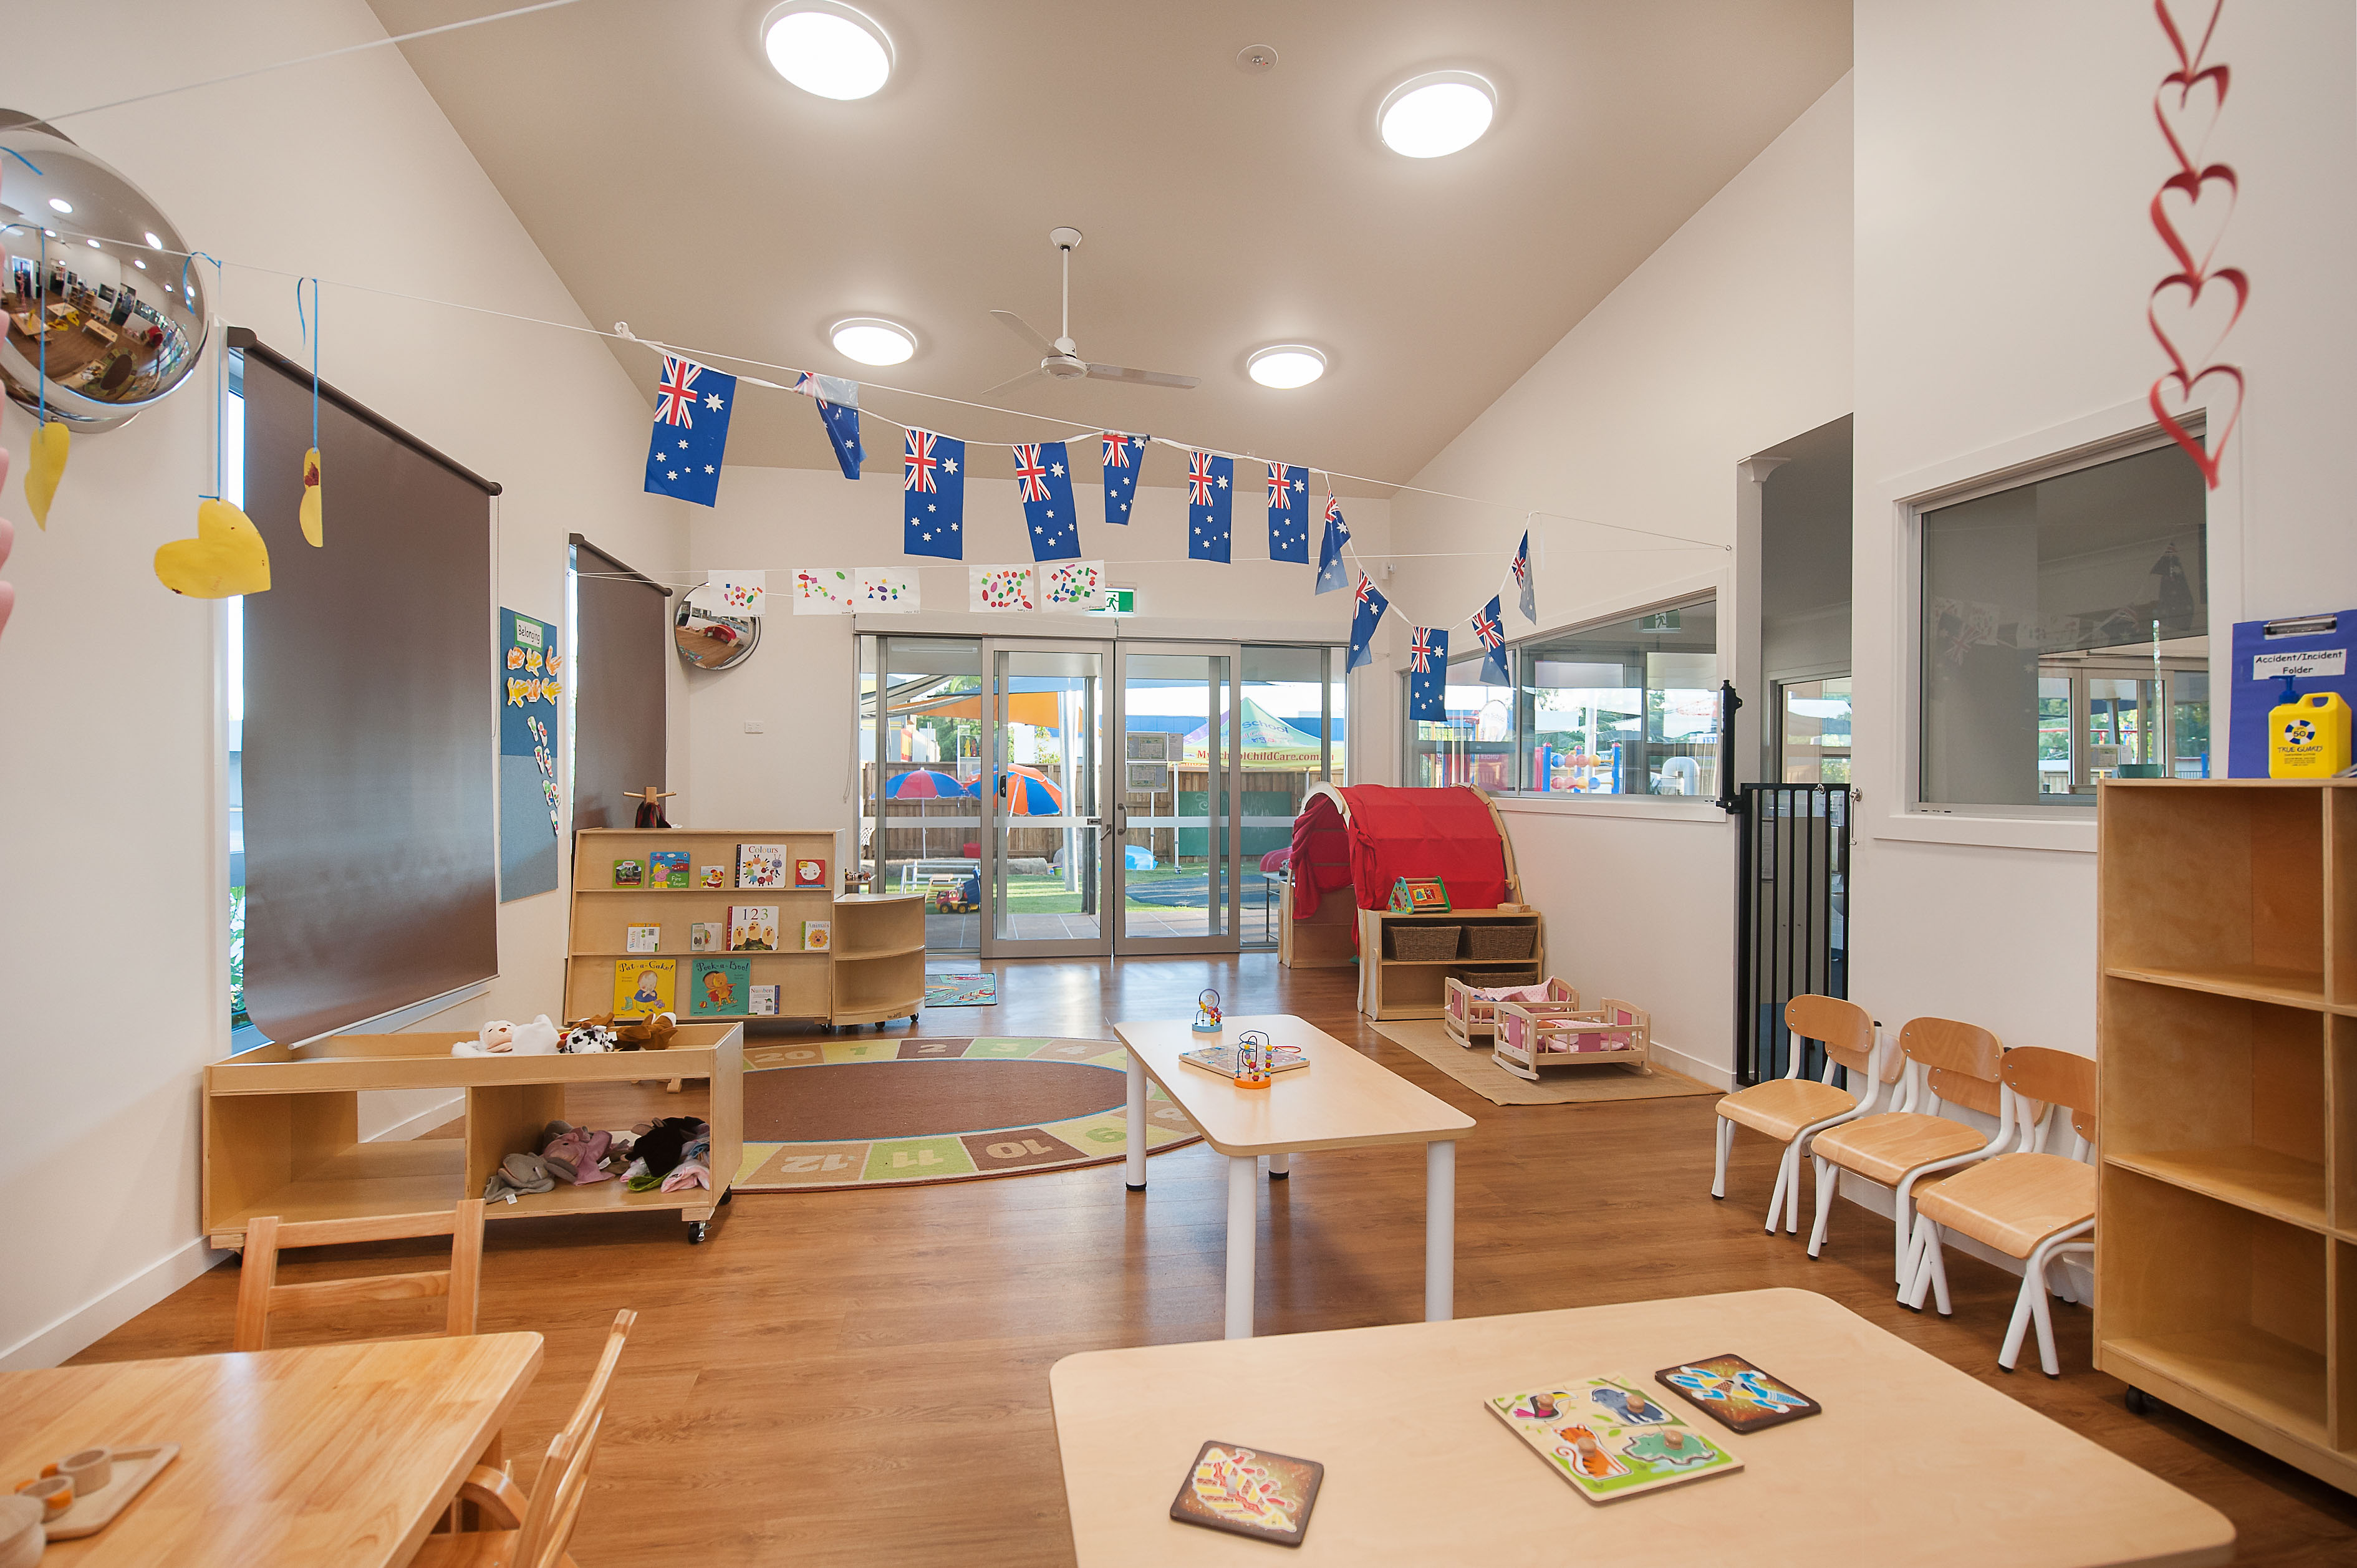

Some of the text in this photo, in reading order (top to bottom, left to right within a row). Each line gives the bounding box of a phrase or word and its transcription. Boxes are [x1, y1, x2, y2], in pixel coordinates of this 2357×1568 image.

[518, 625, 540, 645] Belonging
[2255, 652, 2343, 663] Accident/Incident
[748, 845, 778, 854] Colours
[696, 961, 750, 972] Peek-a-Boo!
[849, 1047, 868, 1056] 1
[917, 1044, 948, 1054] 2
[990, 1043, 1020, 1052] 3
[1056, 1045, 1089, 1055] 4
[754, 1050, 816, 1064] 20
[985, 1138, 1054, 1159] 10
[781, 1153, 856, 1173] 12
[892, 1149, 945, 1168] 11
